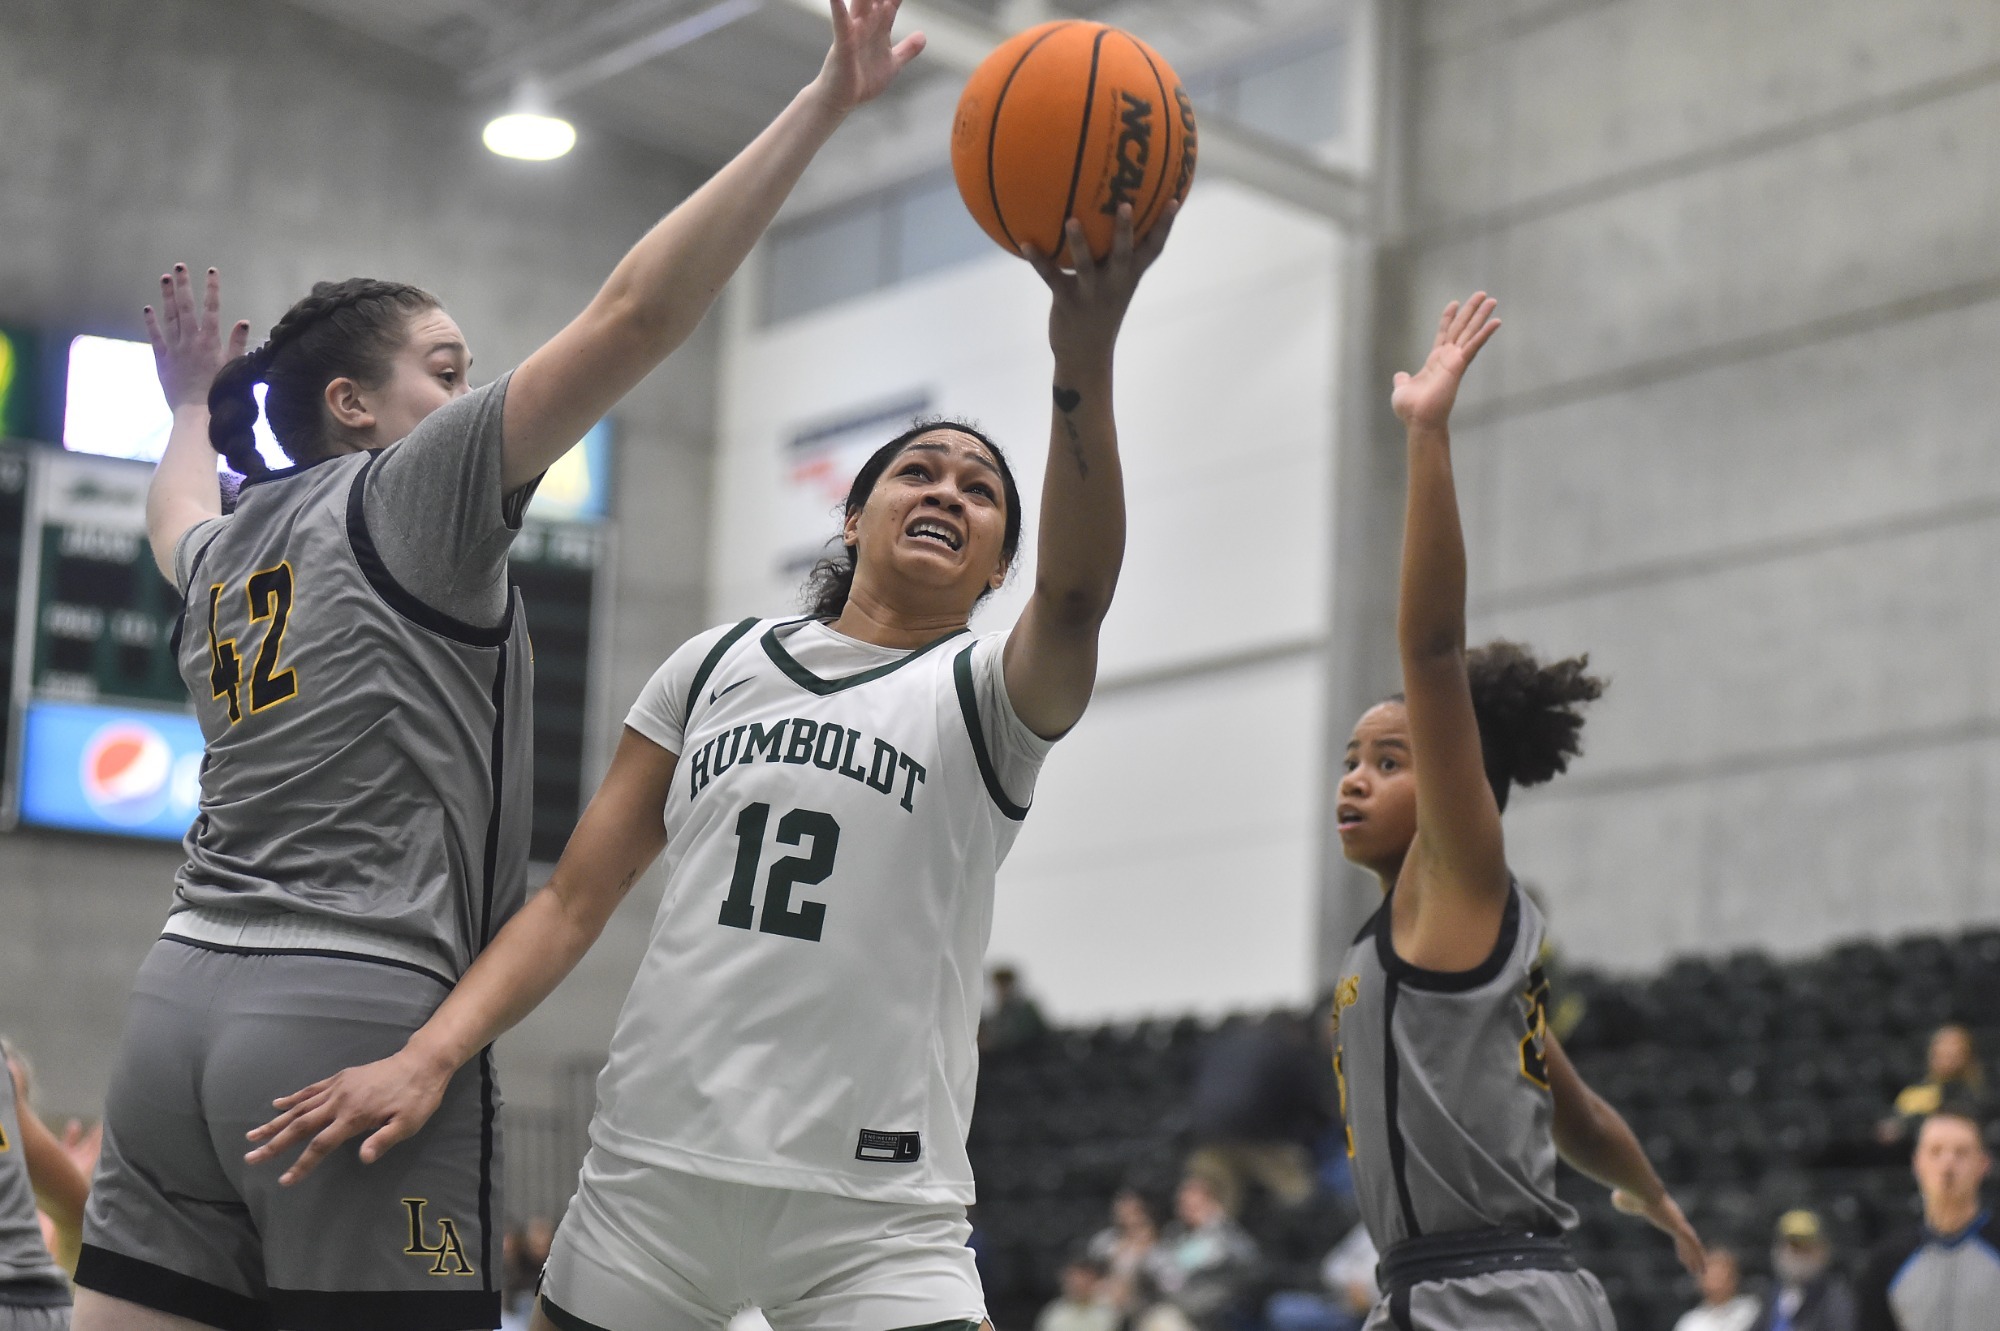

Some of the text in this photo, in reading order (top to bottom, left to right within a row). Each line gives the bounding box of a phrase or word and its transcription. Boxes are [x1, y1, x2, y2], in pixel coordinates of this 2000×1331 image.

[1100, 90, 1152, 215] NCAA
[208, 560, 298, 726] 42
[690, 718, 926, 813] HUMBOLDT
[718, 802, 840, 942] 12
[904, 1142, 911, 1154] L
[401, 1198, 475, 1276] LA
